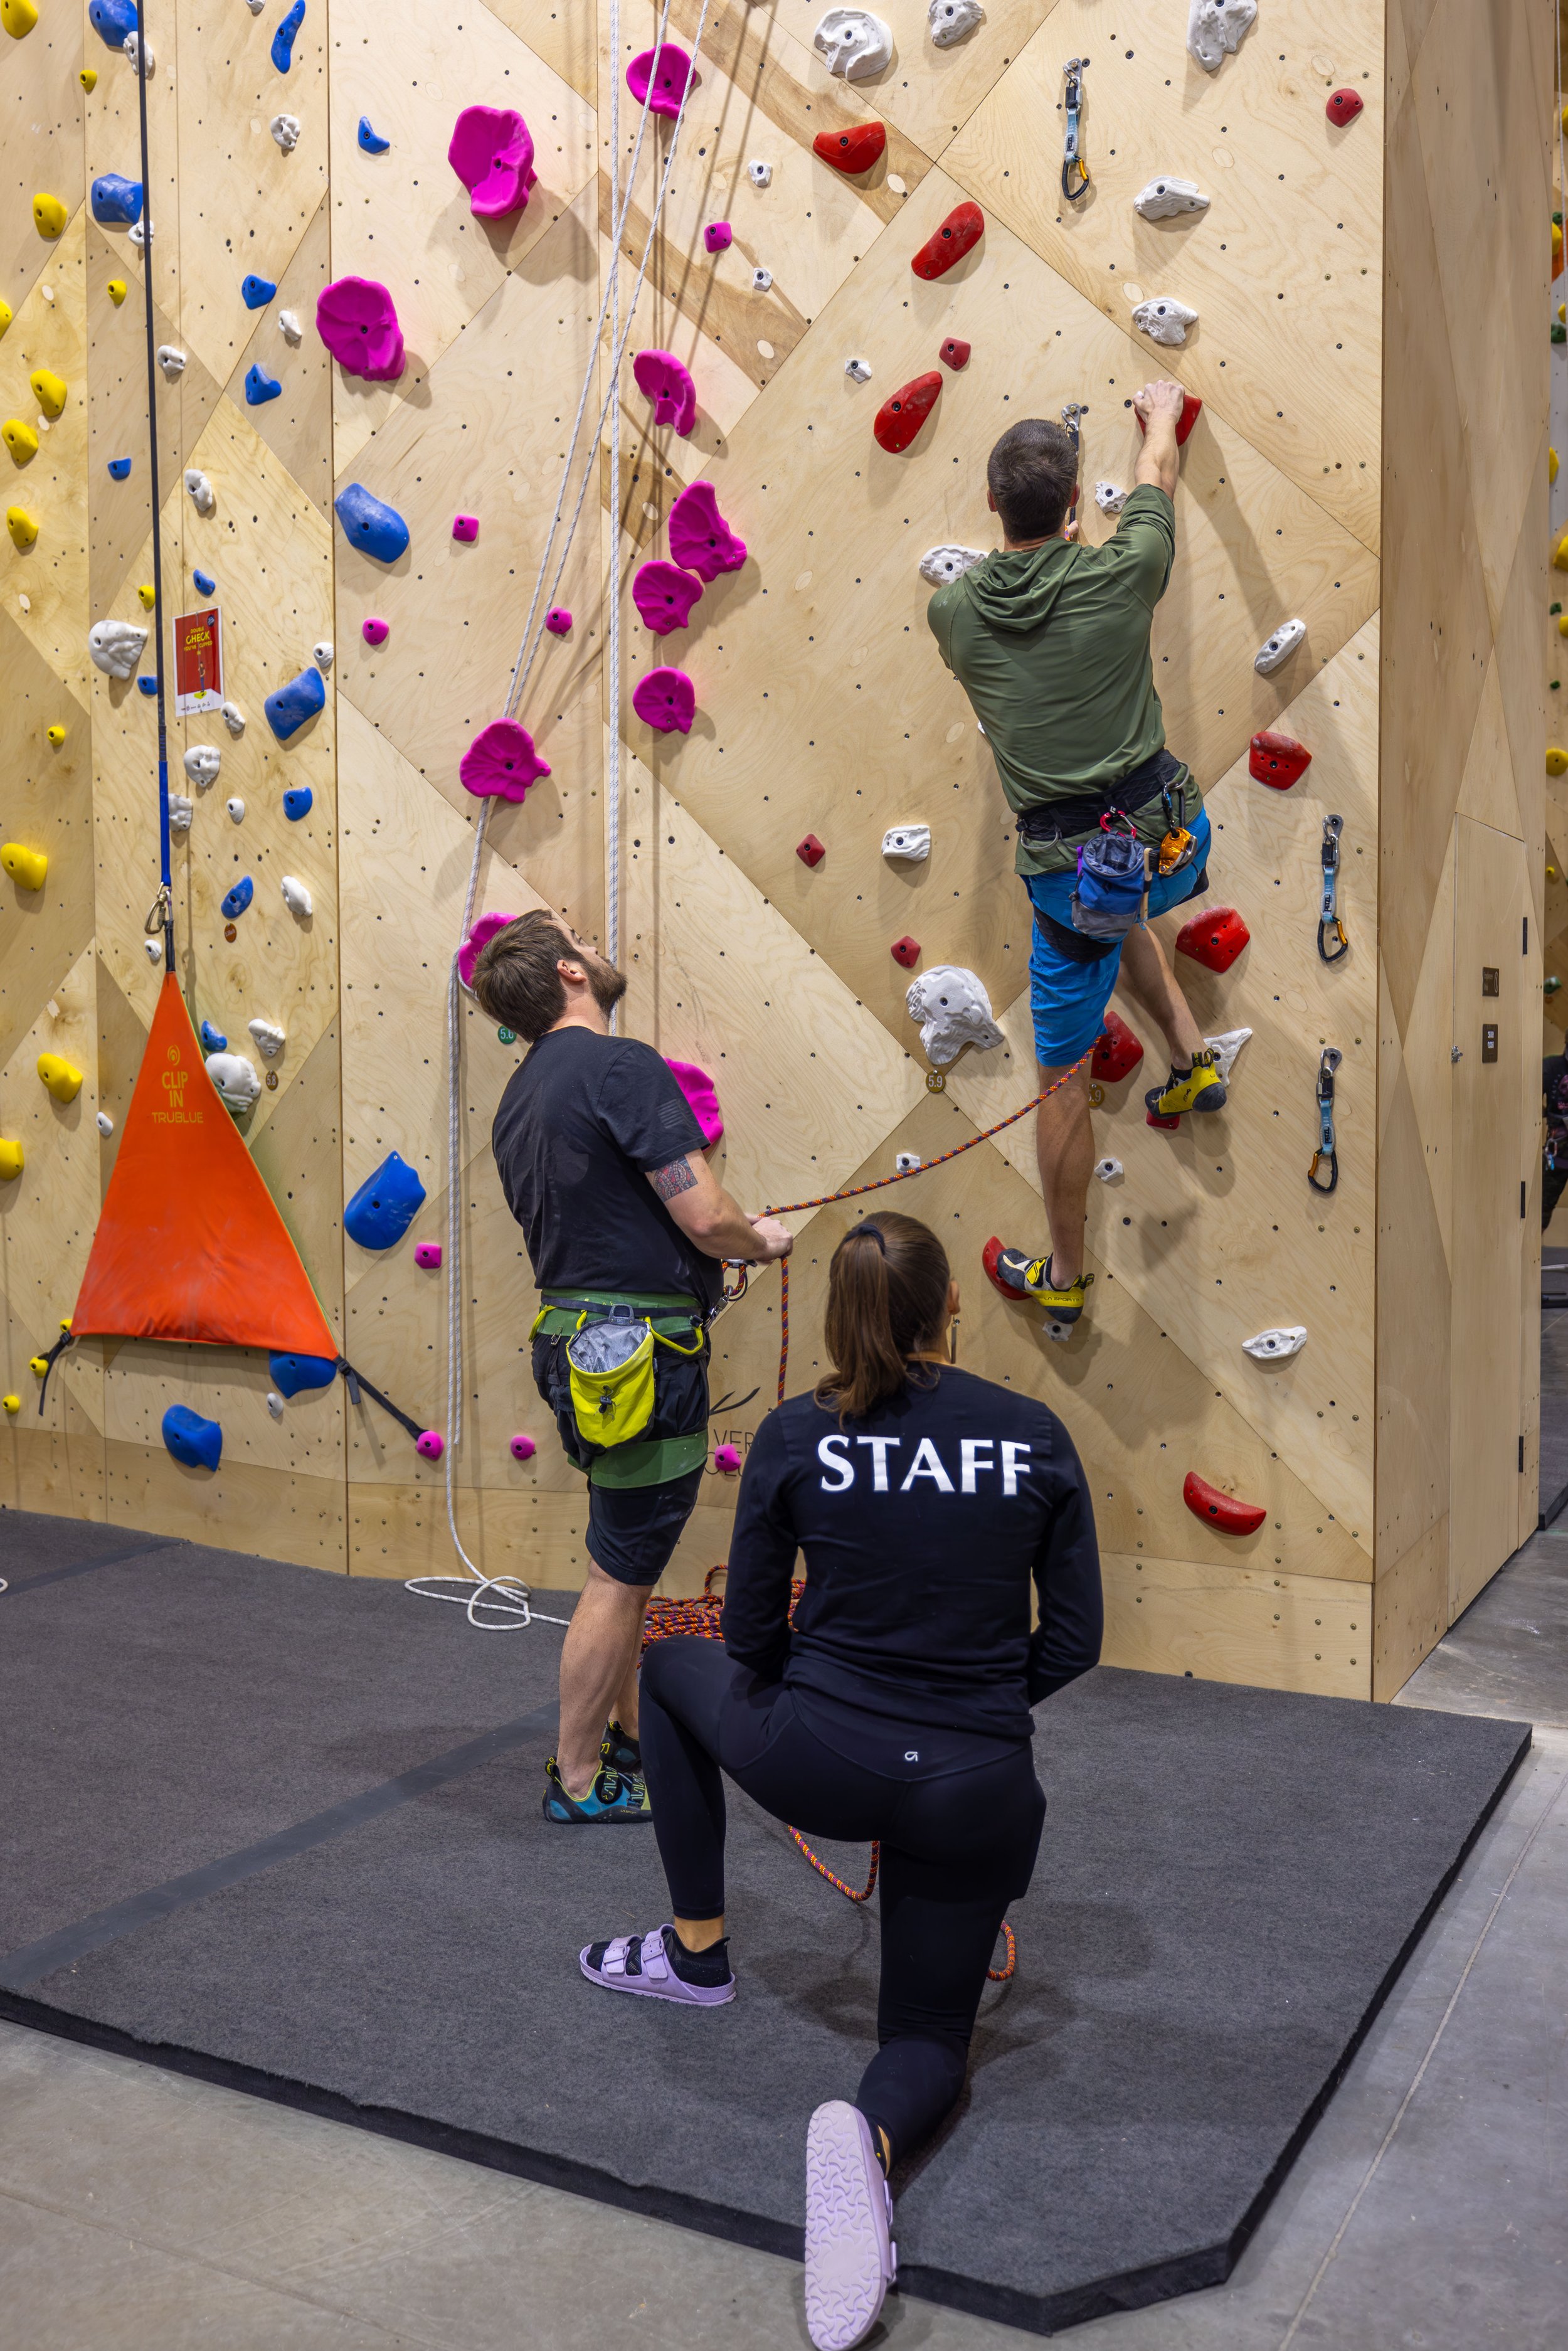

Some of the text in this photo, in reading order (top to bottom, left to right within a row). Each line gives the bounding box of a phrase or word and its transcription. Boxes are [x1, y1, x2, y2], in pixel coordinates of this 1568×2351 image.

[186, 630, 210, 644] CHECK
[161, 1071, 188, 1090] CLIP
[267, 1075, 277, 1086] 5.8
[928, 1075, 943, 1088] 5.9
[169, 1090, 183, 1108] IN
[152, 1112, 204, 1123] TRUBLUE
[1324, 1127, 1332, 1144] PETZL
[817, 1434, 1031, 1496] STAFF
